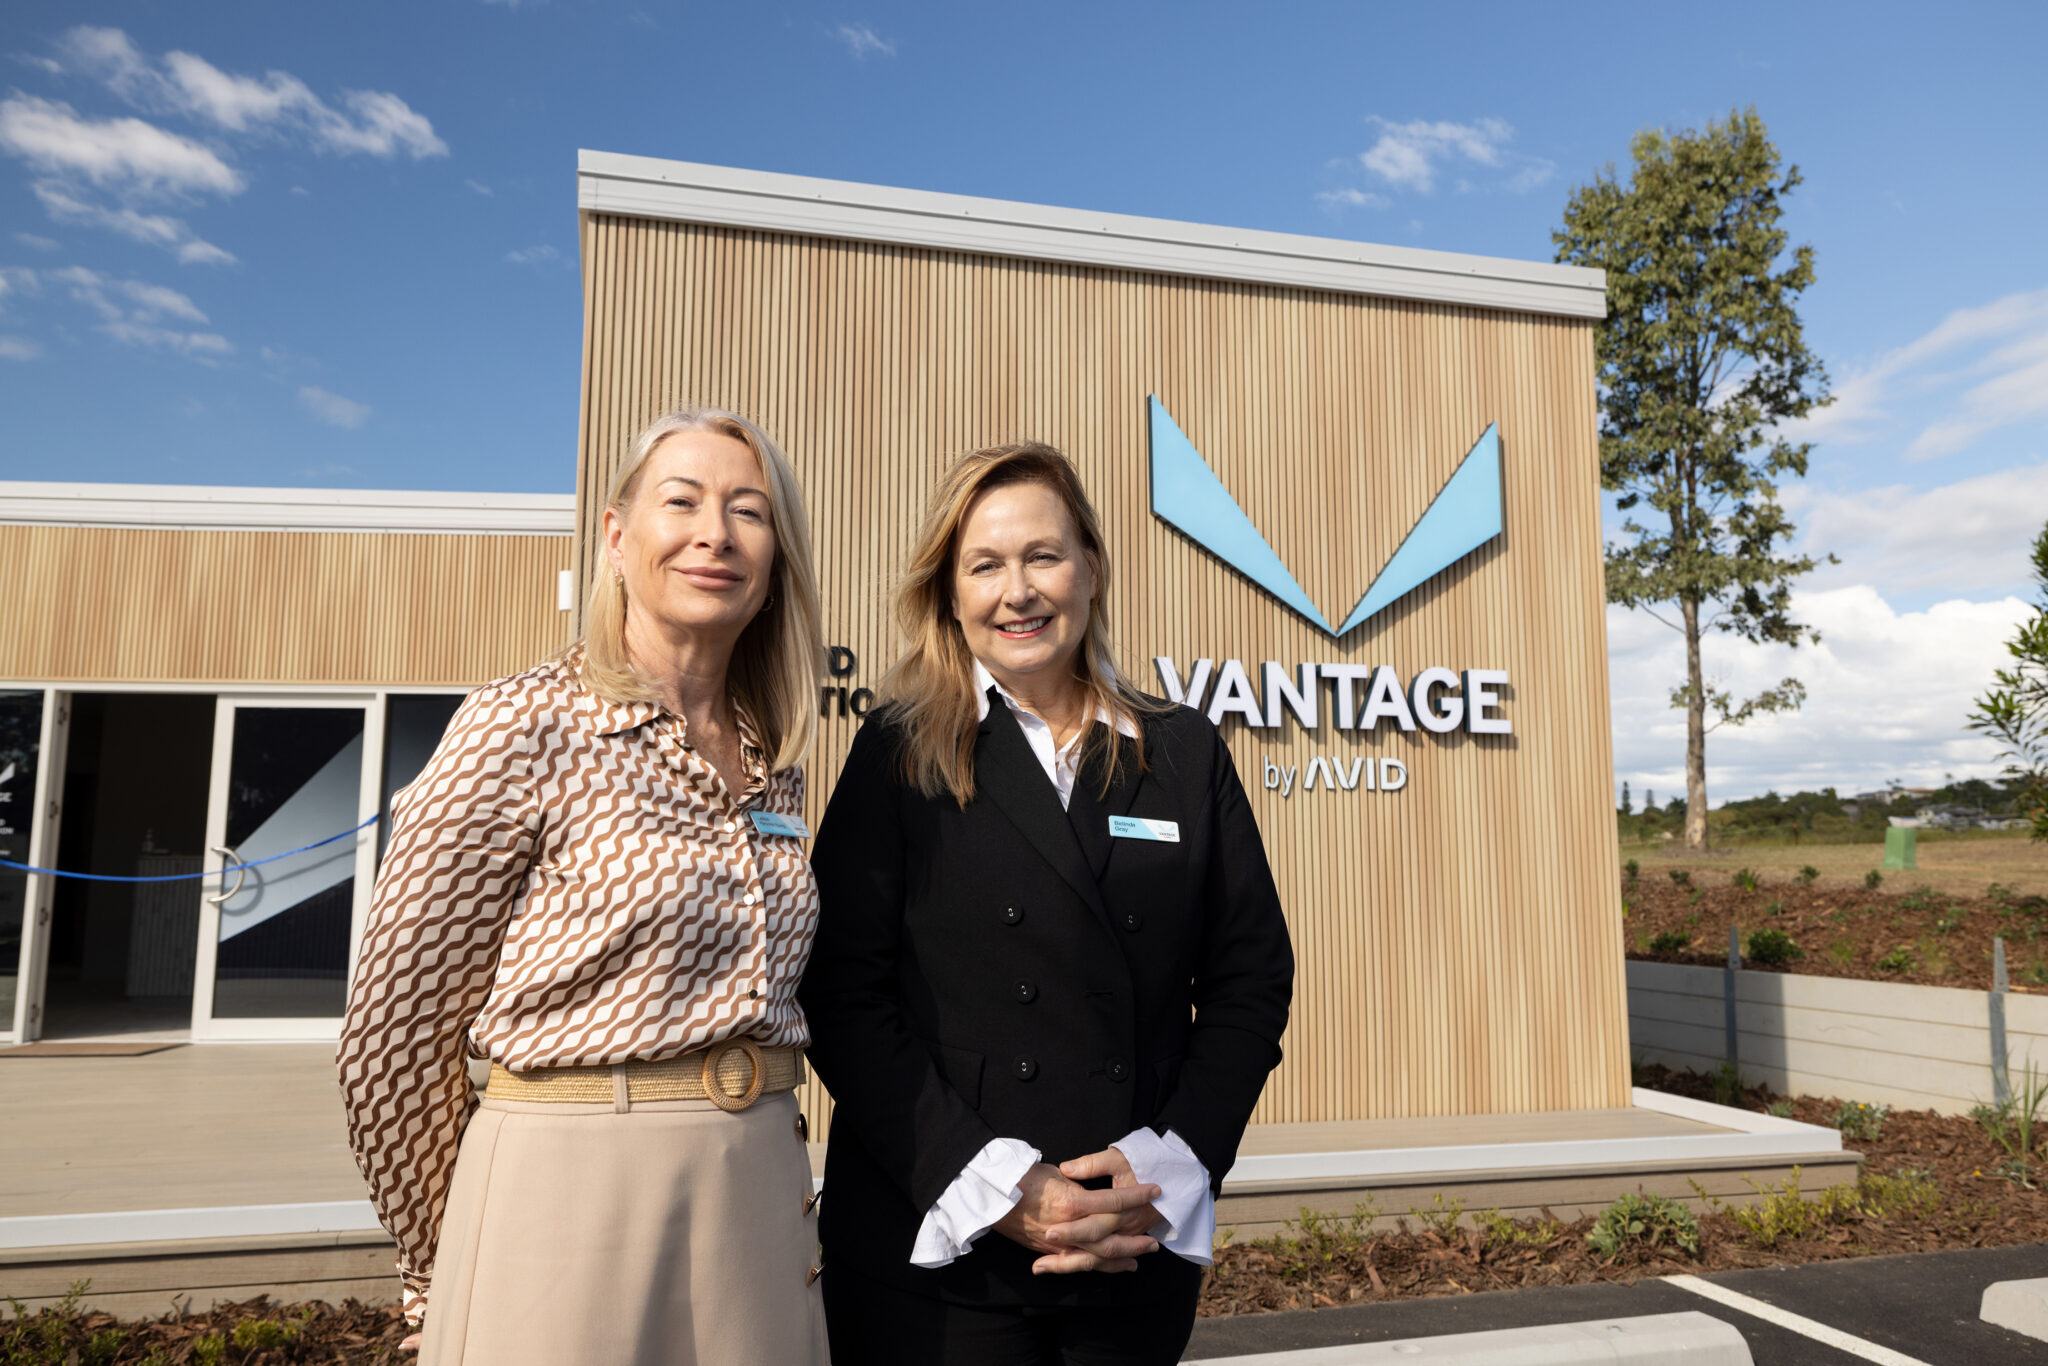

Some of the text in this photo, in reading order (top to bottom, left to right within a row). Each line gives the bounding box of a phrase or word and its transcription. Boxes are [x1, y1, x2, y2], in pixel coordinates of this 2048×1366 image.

[1153, 656, 1513, 734] VANTAGE
[1263, 754, 1408, 798] by AVID
